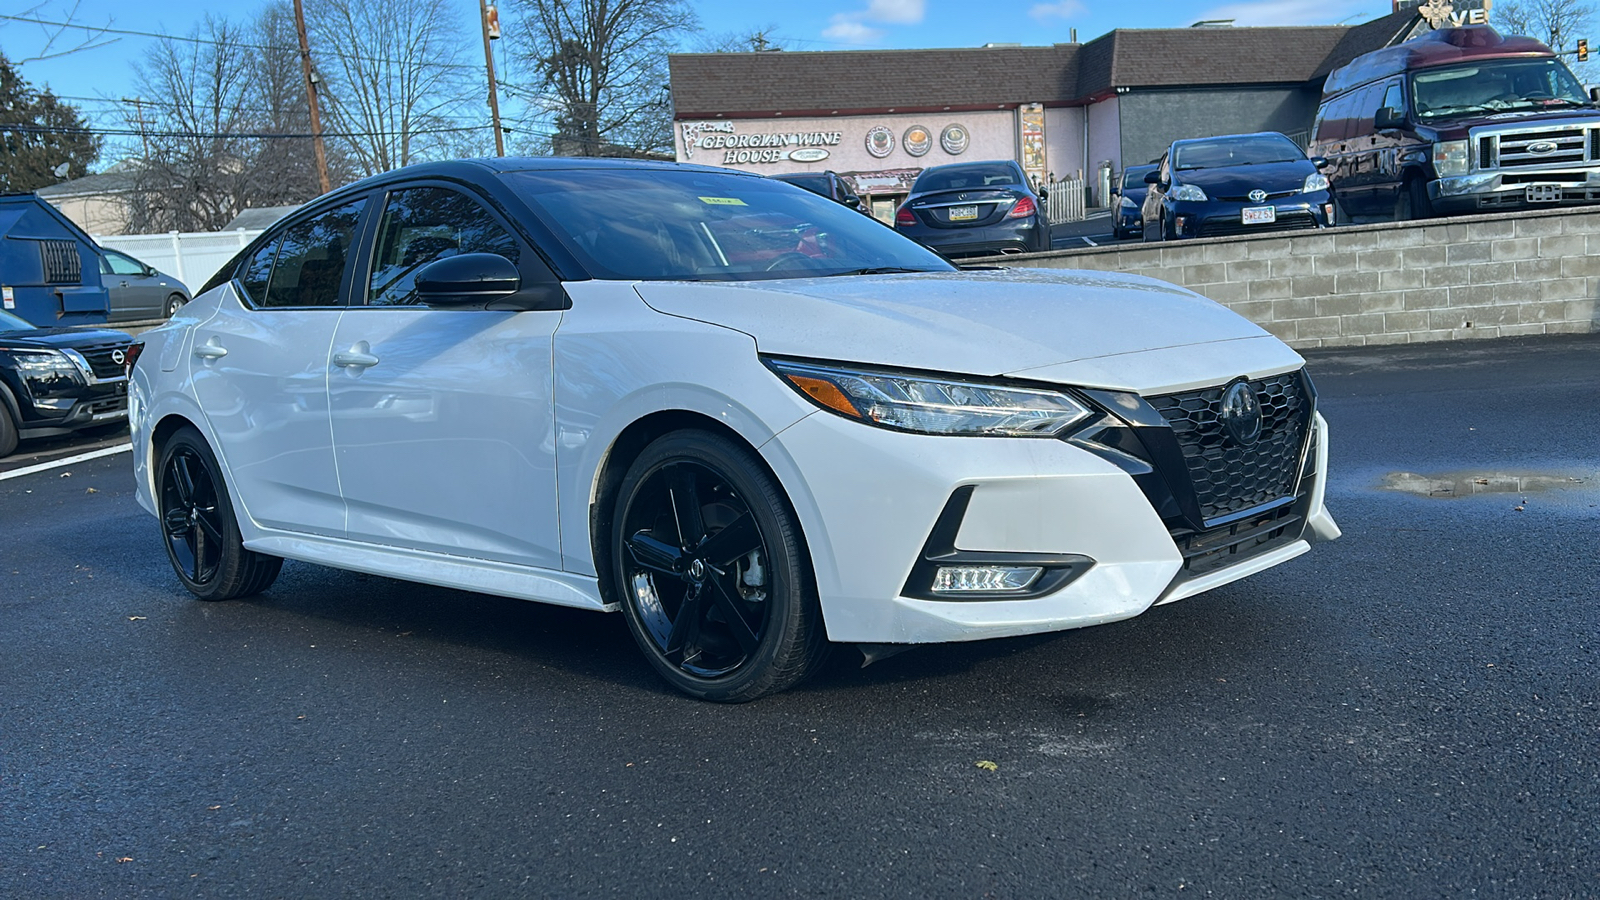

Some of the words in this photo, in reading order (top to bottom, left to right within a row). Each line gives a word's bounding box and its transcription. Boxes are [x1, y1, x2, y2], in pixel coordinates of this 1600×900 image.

[702, 133, 792, 149] GEORGIAN
[796, 131, 843, 145] WINE
[723, 149, 781, 164] HOUSE
